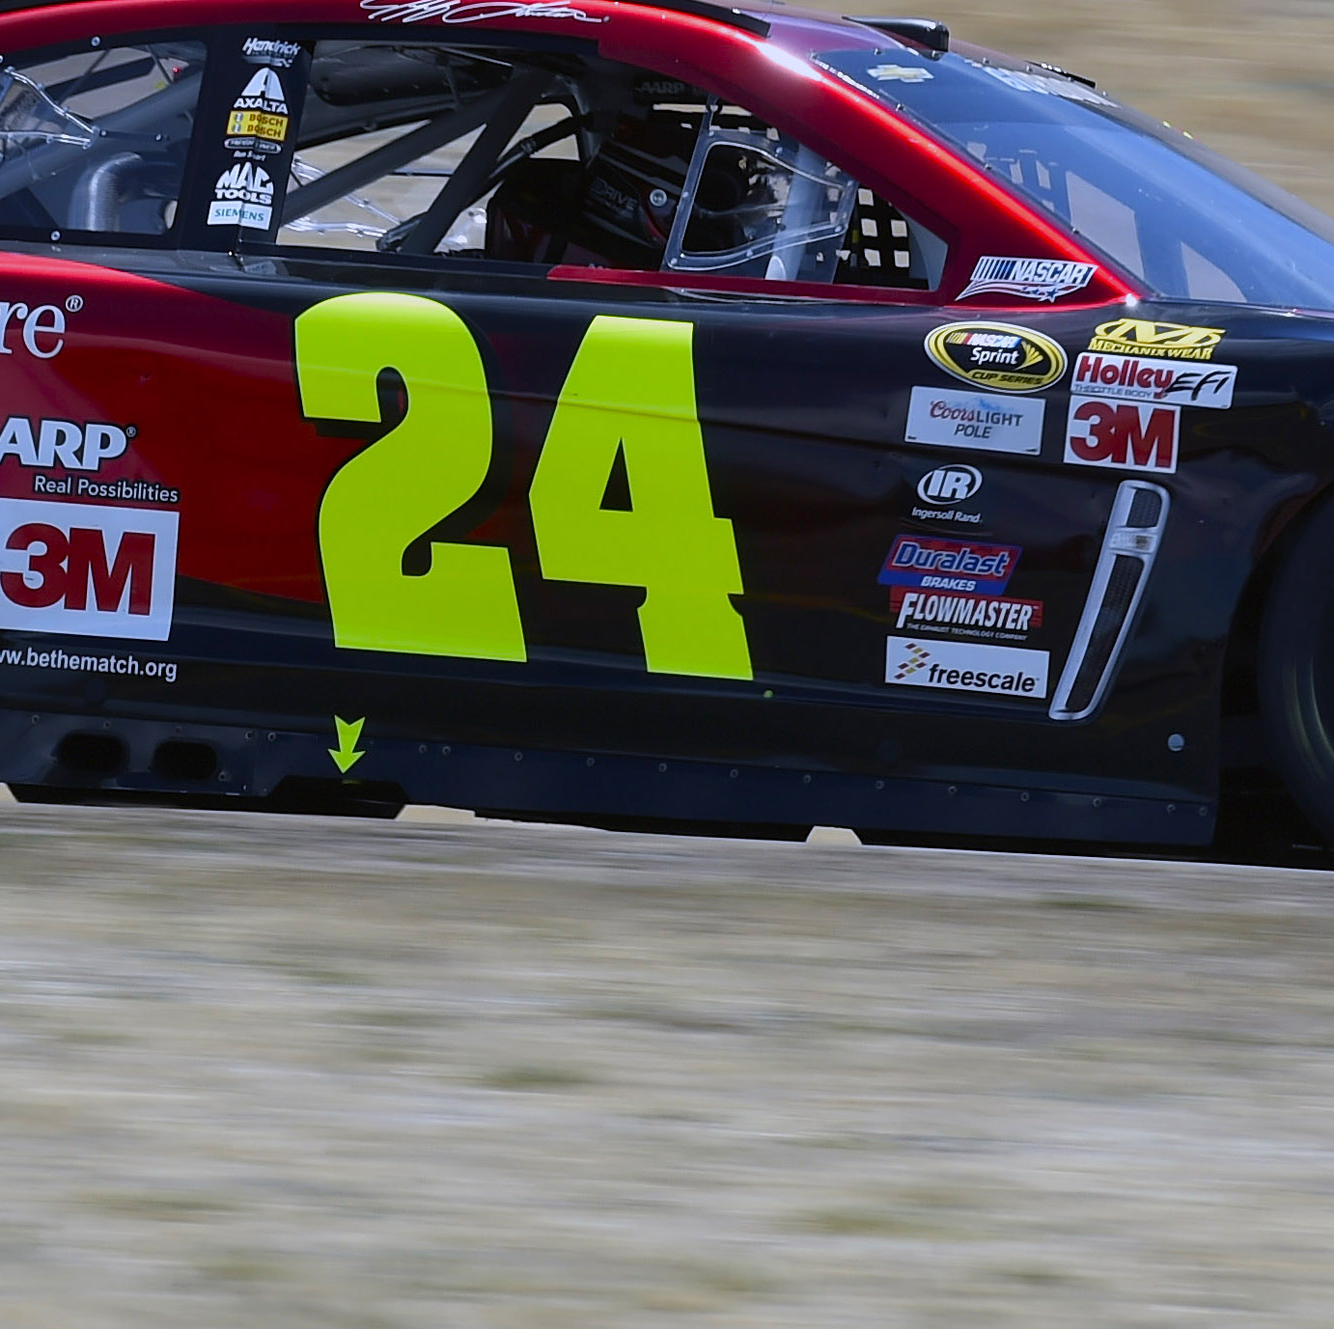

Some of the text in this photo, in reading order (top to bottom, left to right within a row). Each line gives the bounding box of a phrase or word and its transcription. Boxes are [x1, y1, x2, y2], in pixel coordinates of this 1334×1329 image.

[233, 98, 289, 114] AXALTA
[247, 124, 282, 138] BOSCH
[249, 114, 284, 127] BOSCH
[215, 162, 274, 195] MAC
[214, 189, 272, 205] TOOLS
[214, 208, 265, 221] SIEMENS
[1010, 260, 1089, 285] NASCAR
[969, 334, 1019, 348] NASCAR
[1087, 338, 1215, 360] MECHANIX WEAR
[970, 347, 1019, 366] Sprint
[971, 371, 1044, 385] CUP SERIES
[1075, 355, 1233, 401] Holley EFI
[930, 400, 1024, 427] Coors LIGHT
[954, 424, 993, 439] POLE
[1069, 401, 1177, 469] 3M
[34, 475, 179, 503] Real Possibilities
[293, 291, 754, 681] 24
[926, 469, 973, 500] IR
[911, 507, 981, 523] Ingersoll Rand
[0, 522, 157, 617] 3M
[892, 541, 1011, 577] Duralast
[920, 575, 978, 592] BRAKES
[895, 592, 1034, 632] FLOWMASTER
[928, 663, 1037, 692] freescale
